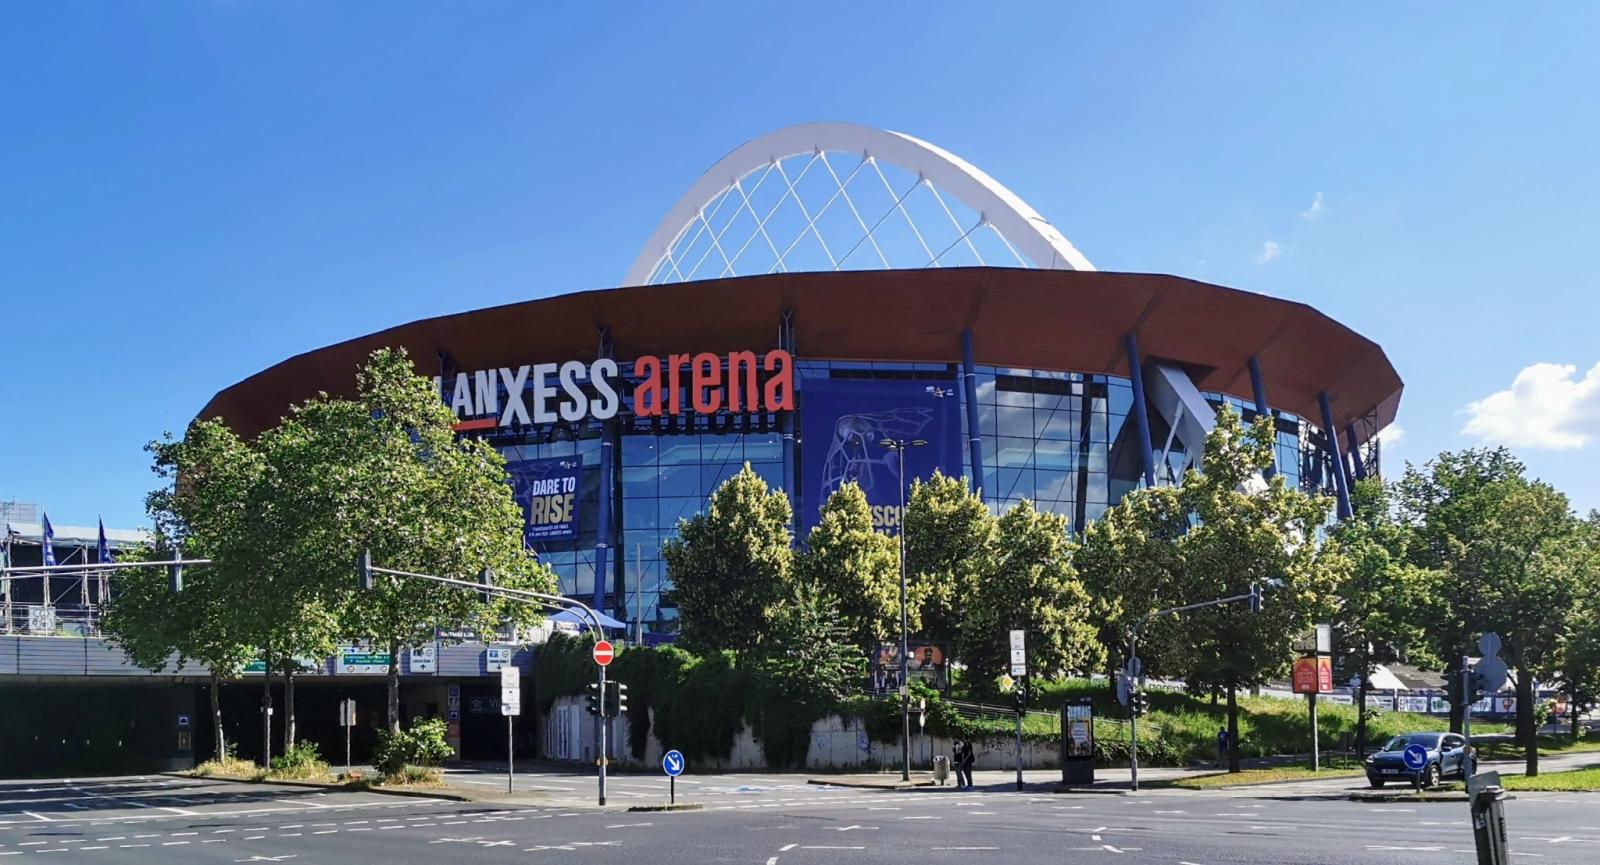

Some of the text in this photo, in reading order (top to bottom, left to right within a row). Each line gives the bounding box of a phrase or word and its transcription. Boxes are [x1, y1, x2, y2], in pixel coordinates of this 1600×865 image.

[633, 349, 795, 417] arena
[532, 476, 576, 496] DARE TO
[530, 494, 575, 525] RISE
